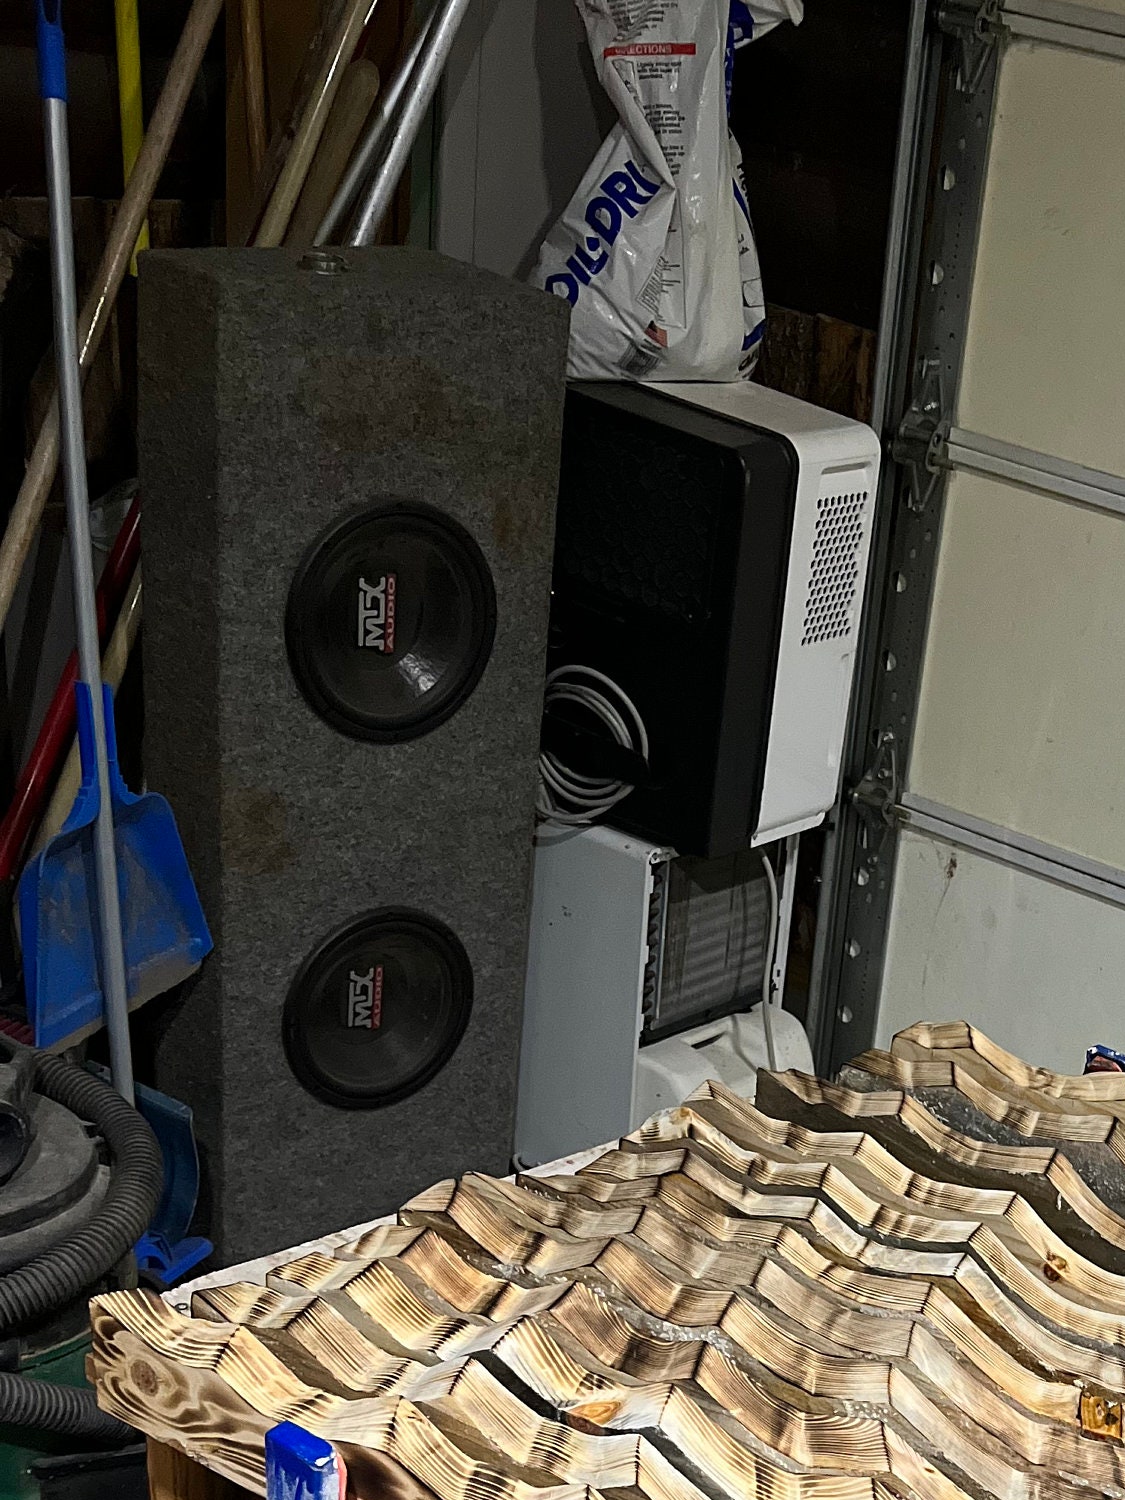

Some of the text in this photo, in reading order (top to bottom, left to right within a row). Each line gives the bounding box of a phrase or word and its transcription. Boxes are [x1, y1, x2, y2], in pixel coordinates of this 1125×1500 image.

[358, 576, 386, 651] MTX
[386, 577, 396, 650] AUDIO
[348, 967, 374, 1029] MTX
[373, 967, 383, 1028] AUDIO
